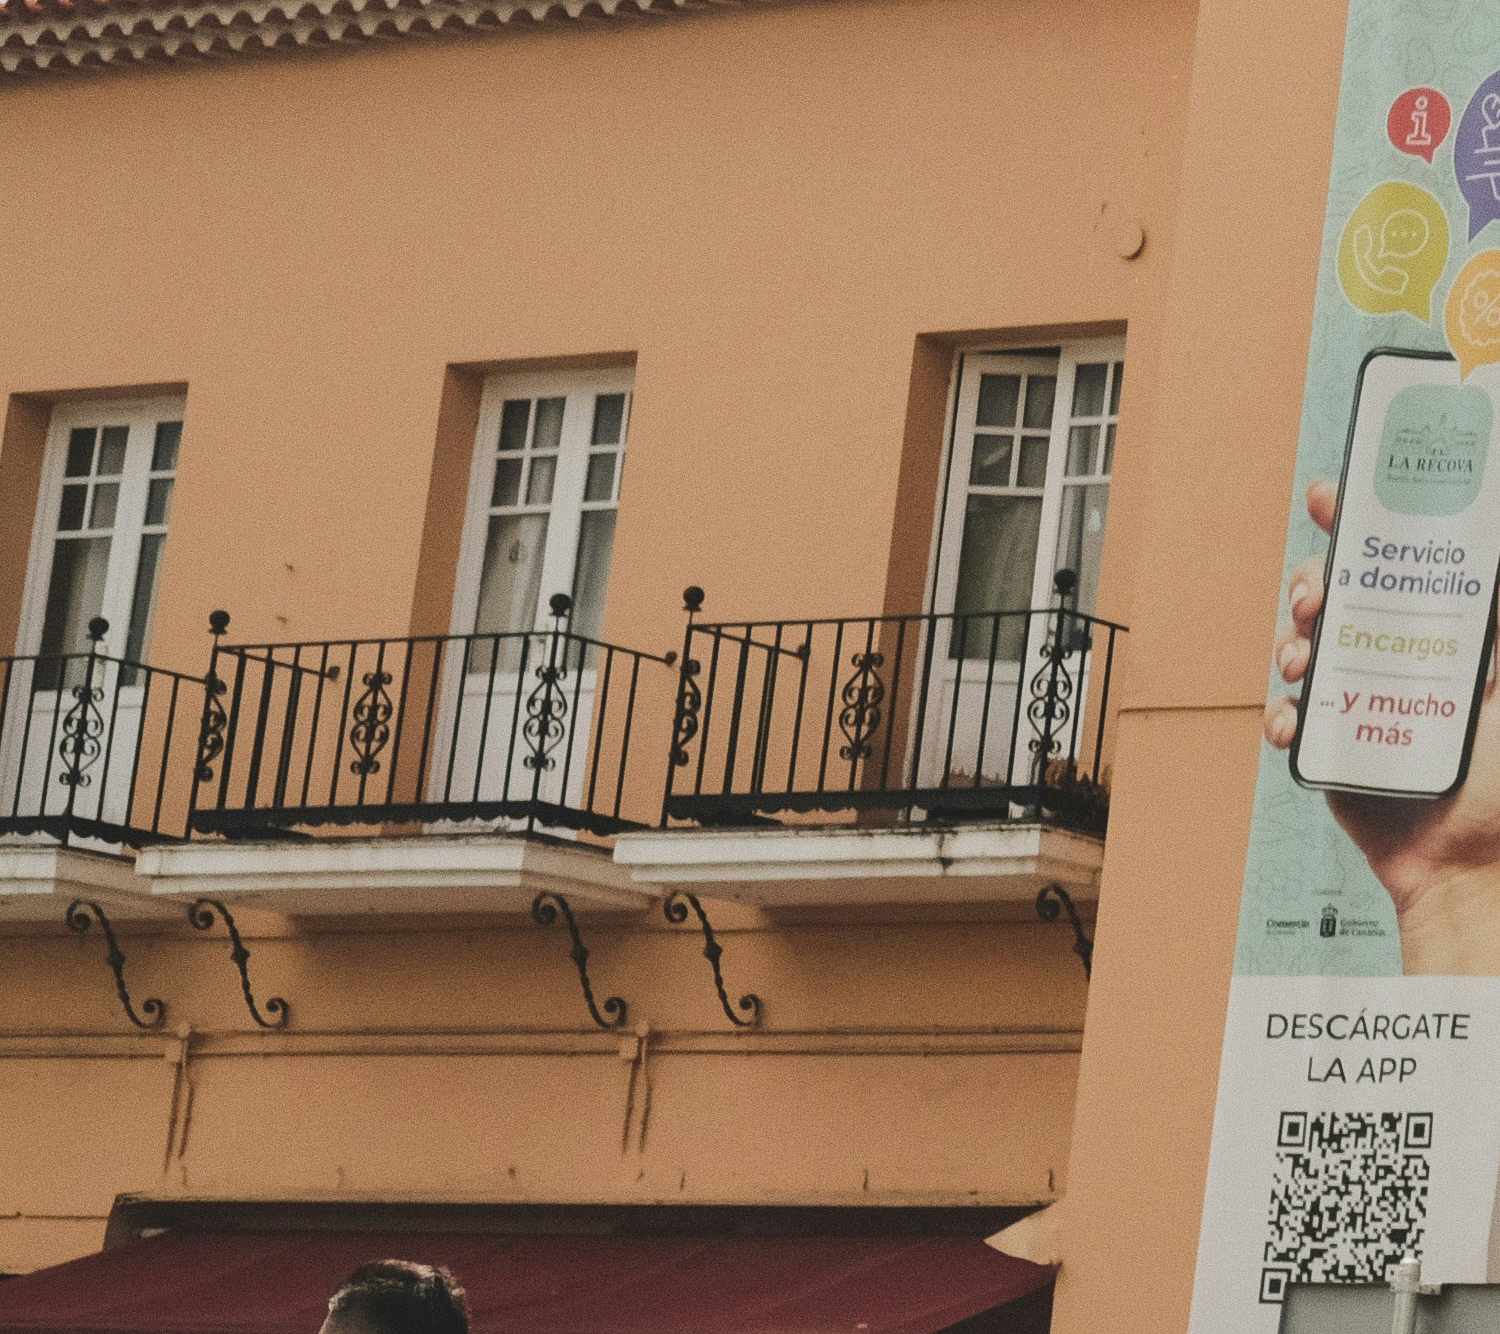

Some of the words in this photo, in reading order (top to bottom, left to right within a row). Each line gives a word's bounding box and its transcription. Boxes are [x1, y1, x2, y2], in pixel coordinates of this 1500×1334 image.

[1362, 535, 1467, 565] Servicio
[1338, 569, 1351, 587] a
[1360, 566, 1482, 597] domicilio
[1337, 624, 1459, 660] Encargos
[1340, 690, 1360, 714] y
[1368, 692, 1458, 719] mucho
[1354, 721, 1414, 747] más
[1266, 1008, 1471, 1041] DESCÁRGATE
[1307, 1057, 1347, 1084] LA
[1356, 1057, 1419, 1084] APP
